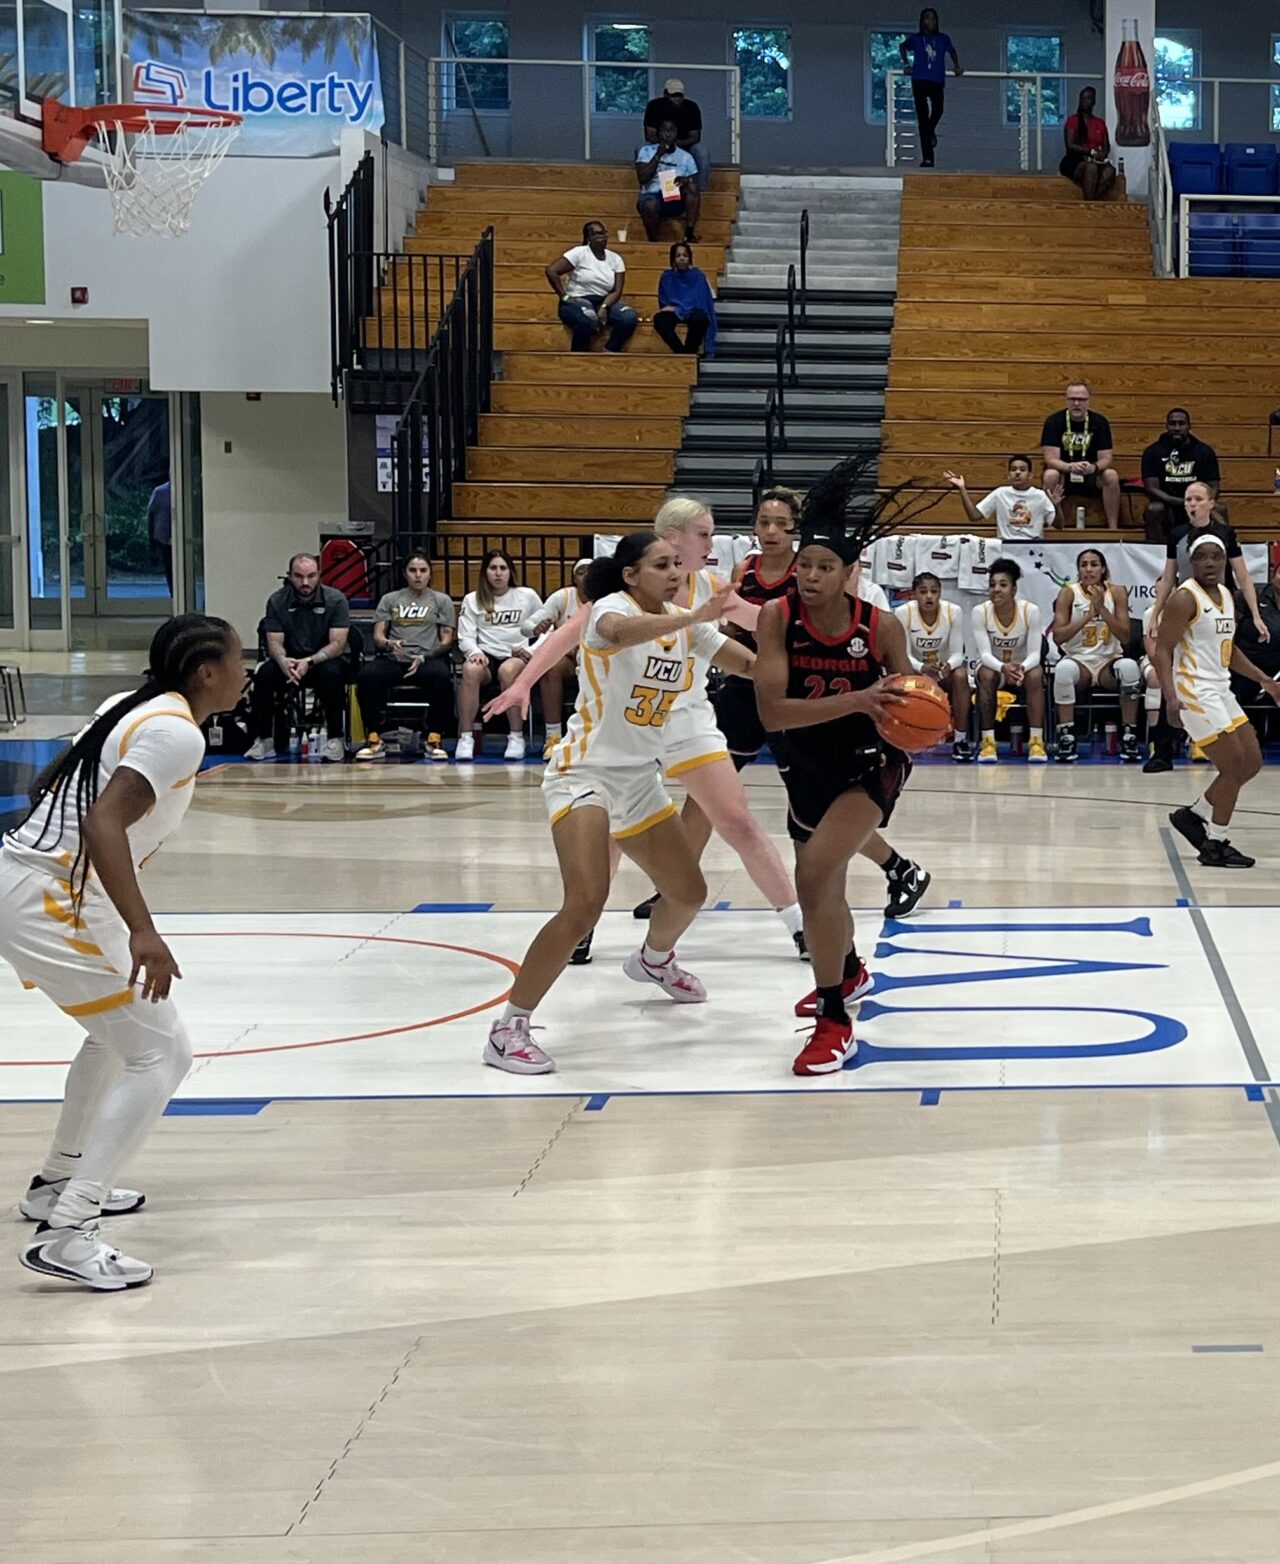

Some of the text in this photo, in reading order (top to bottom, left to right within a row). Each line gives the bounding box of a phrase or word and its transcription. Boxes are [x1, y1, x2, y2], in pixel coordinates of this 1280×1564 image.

[205, 70, 373, 122] Liberty
[399, 605, 430, 618] VCU
[491, 610, 522, 625] VCU
[916, 637, 942, 649] VCU
[993, 637, 1019, 648] VCU
[644, 656, 682, 682] VCU
[791, 655, 869, 671] GEORGIA
[804, 675, 851, 699] 22
[624, 684, 679, 727] 35
